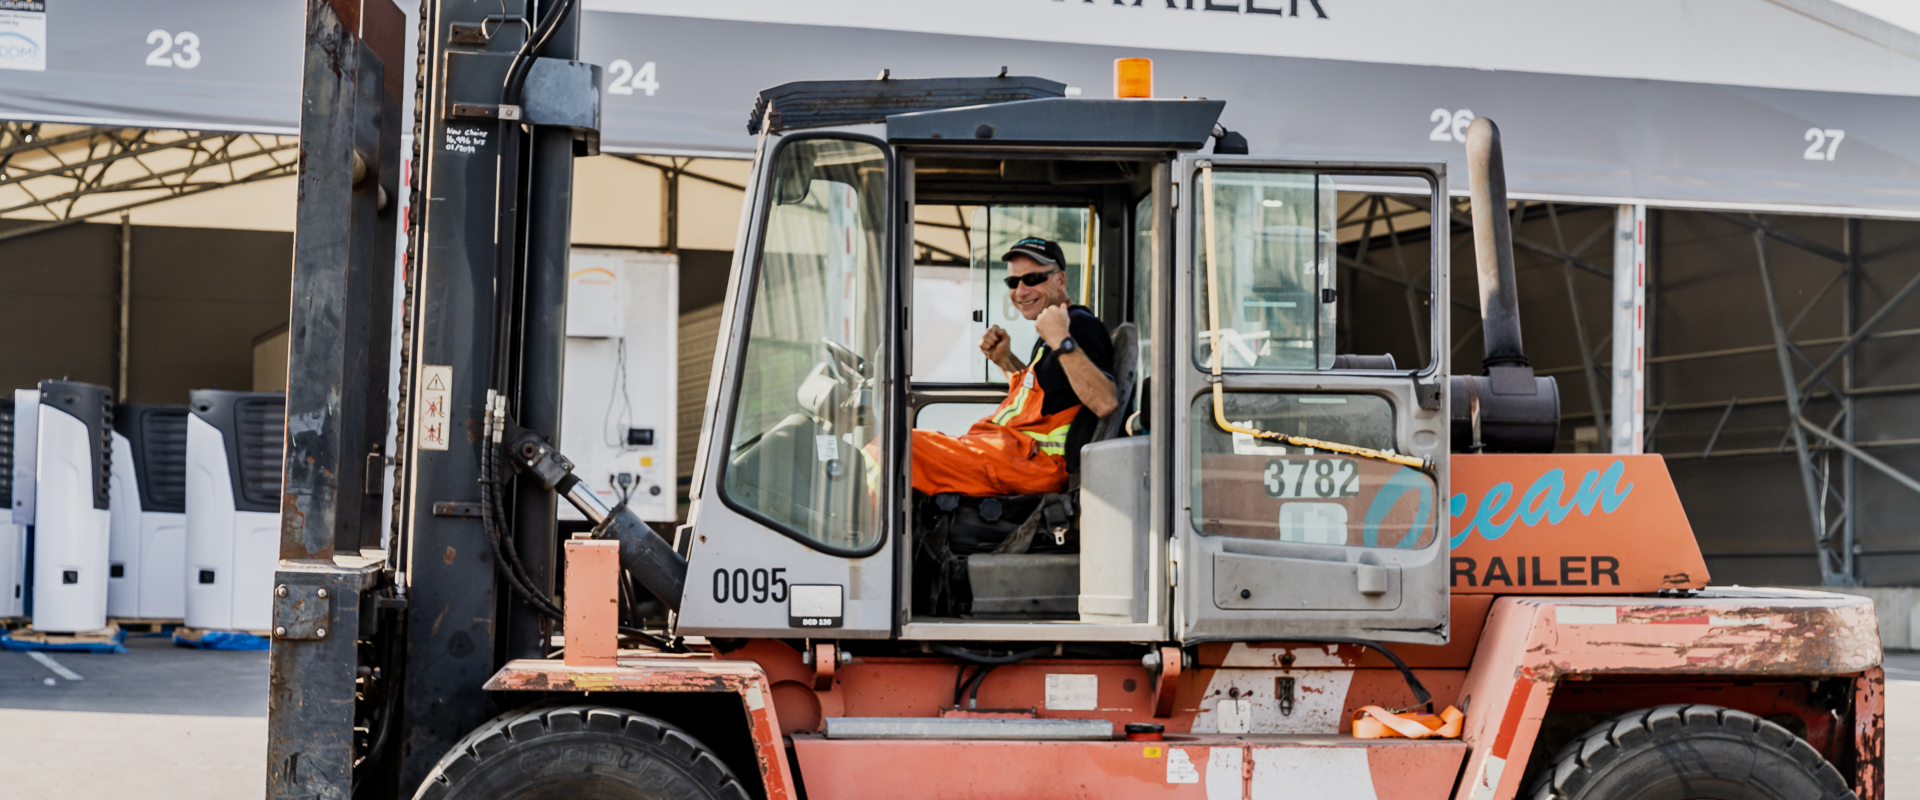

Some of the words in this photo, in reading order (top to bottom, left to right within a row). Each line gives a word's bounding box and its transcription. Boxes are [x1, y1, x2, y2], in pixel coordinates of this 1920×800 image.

[145, 29, 201, 69] 23
[607, 58, 660, 97] 24
[1429, 108, 1475, 144] 26
[1803, 127, 1846, 161] 27
[1265, 459, 1359, 497] 3782
[713, 567, 788, 604] 0095
[1449, 556, 1620, 587] RAILER
